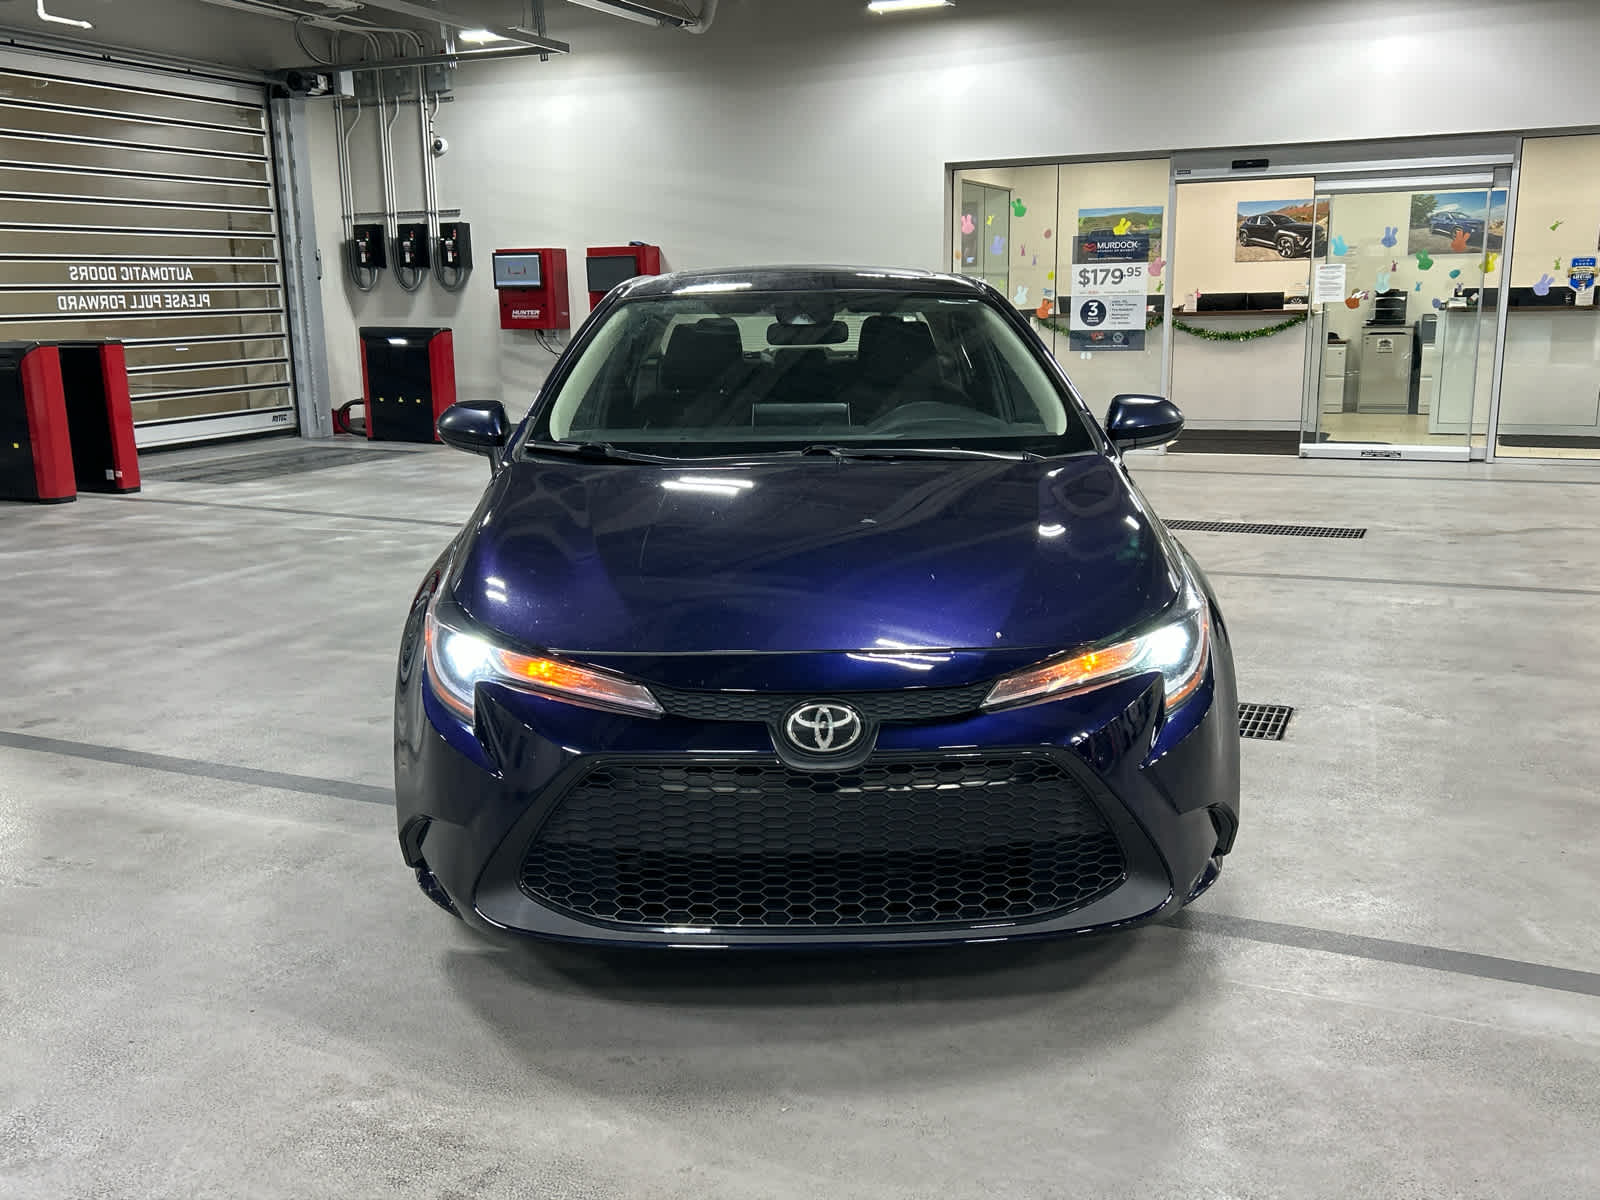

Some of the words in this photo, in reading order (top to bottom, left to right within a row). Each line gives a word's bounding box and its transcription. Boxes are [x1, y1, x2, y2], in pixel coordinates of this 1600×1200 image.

[1097, 241, 1138, 249] MURDOCK
[1078, 266, 1142, 288] $179.95
[1087, 302, 1099, 316] 3
